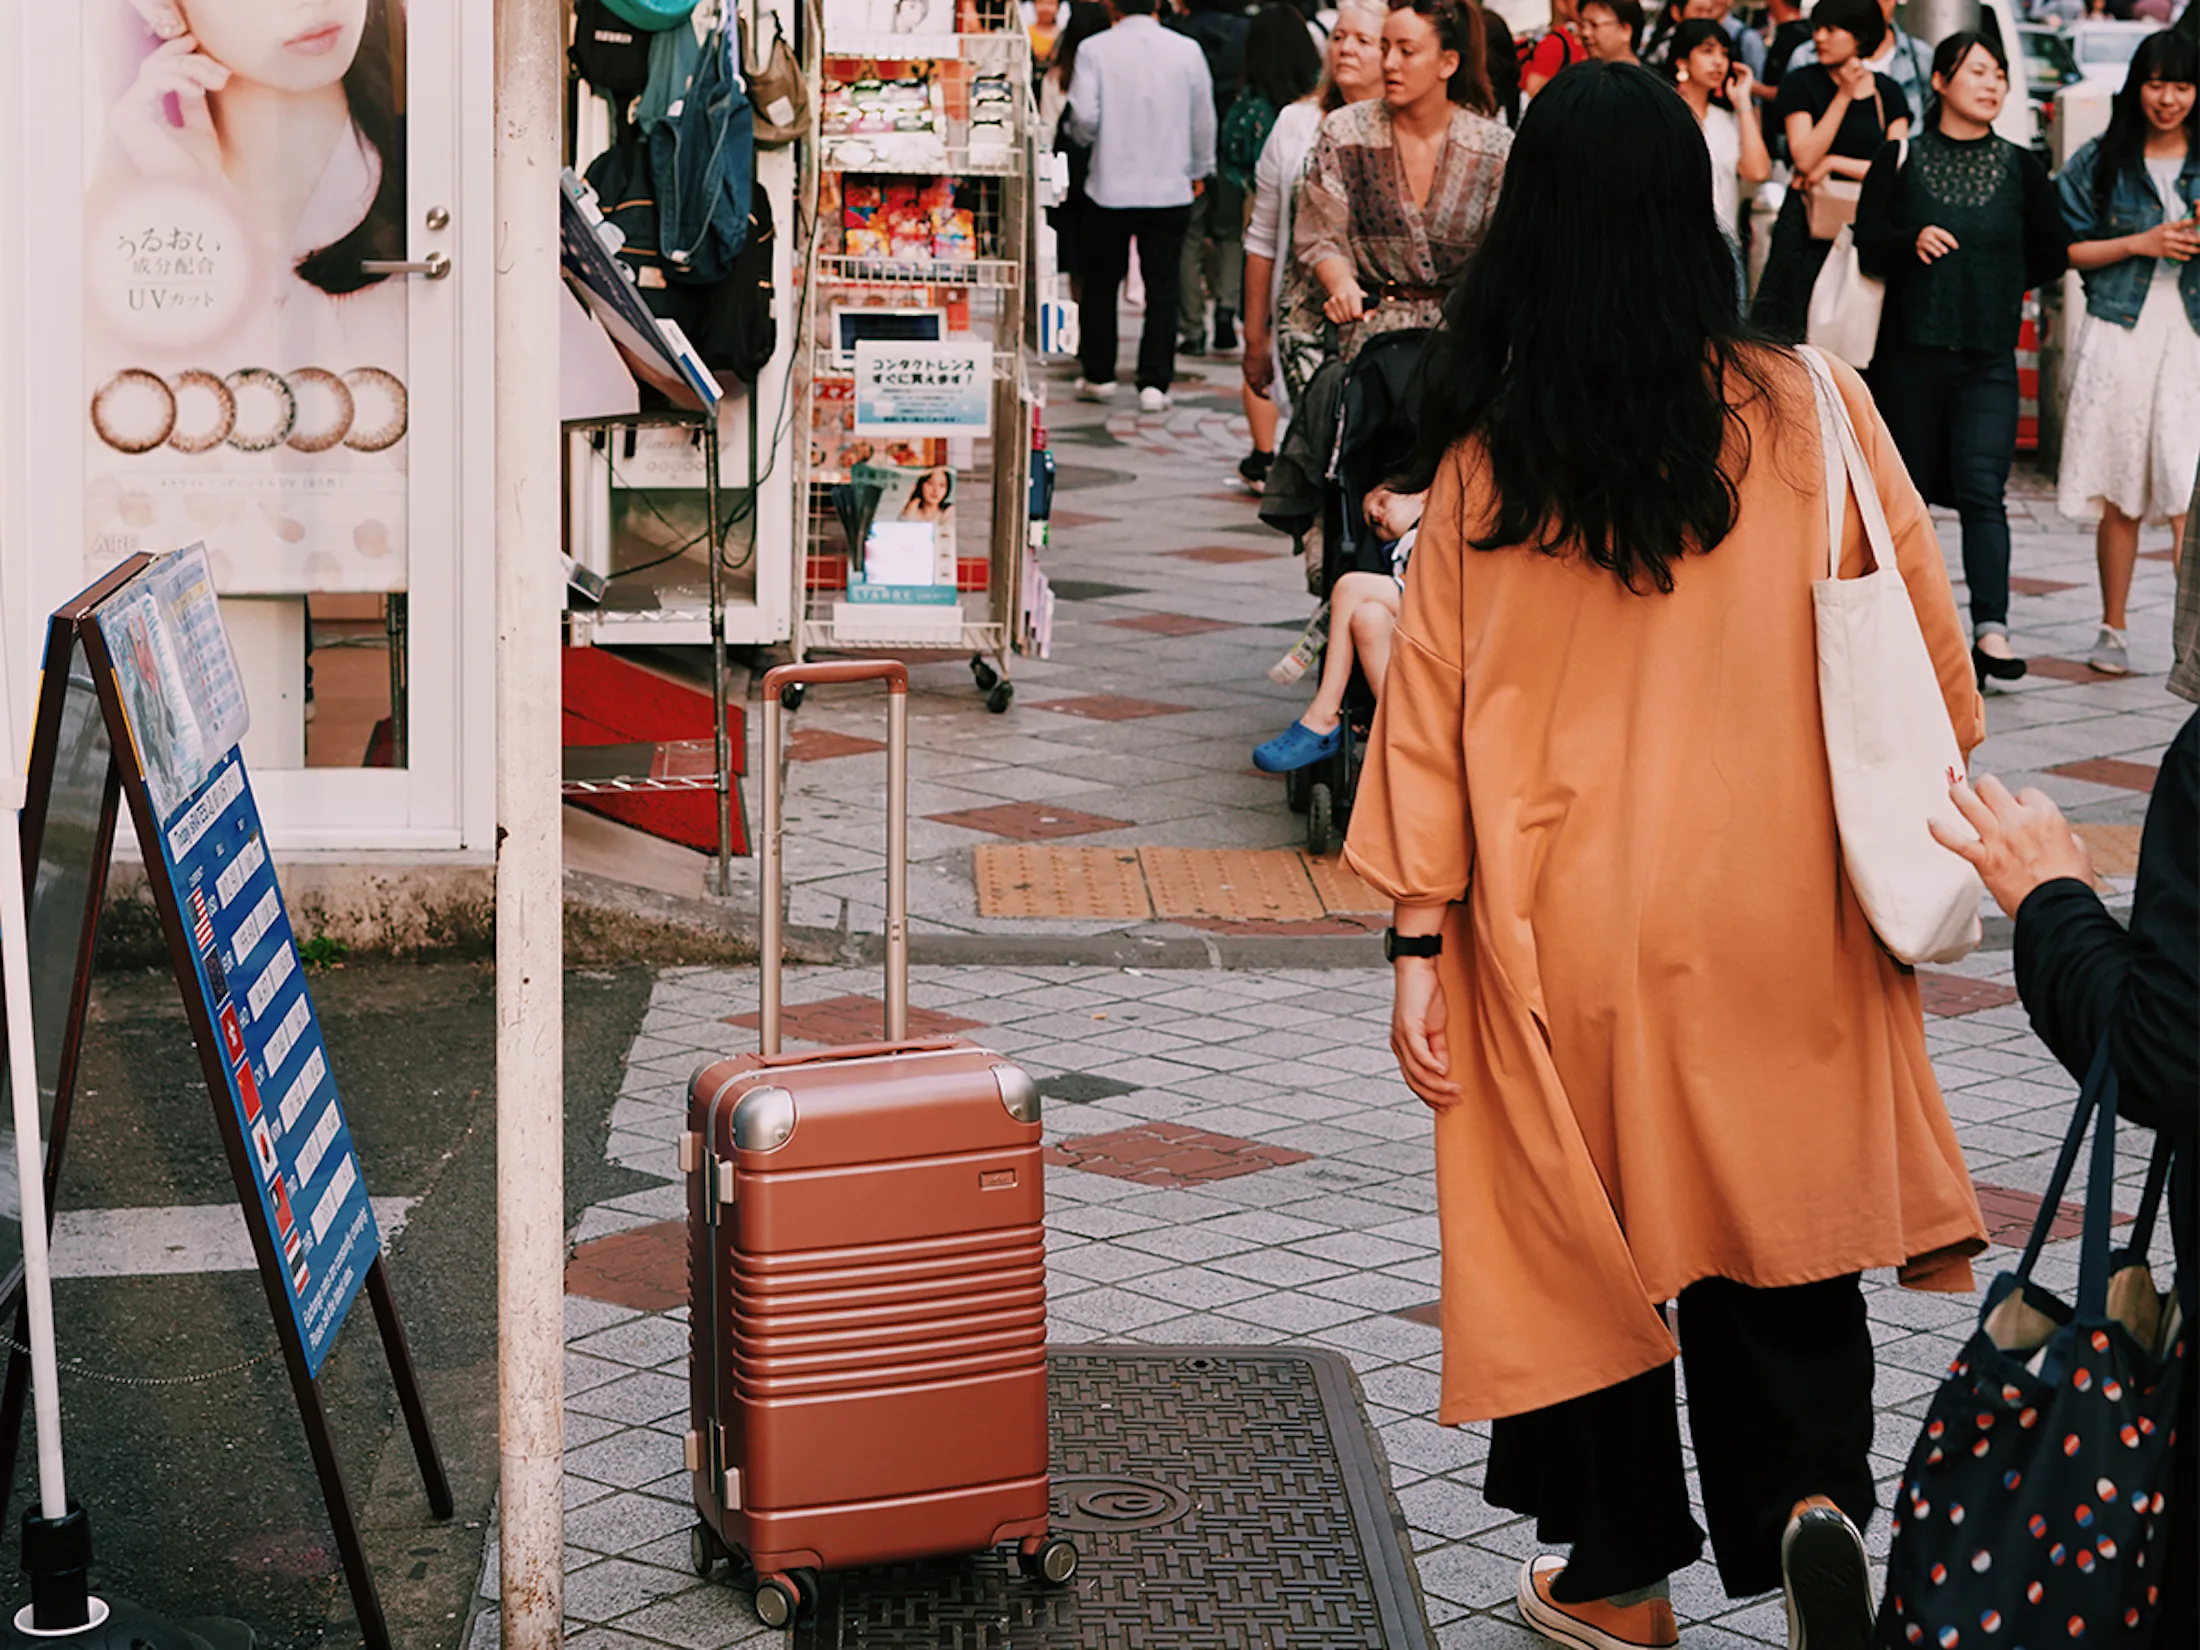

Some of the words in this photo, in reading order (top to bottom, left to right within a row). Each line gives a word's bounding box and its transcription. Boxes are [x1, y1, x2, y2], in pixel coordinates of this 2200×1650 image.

[117, 226, 221, 260] うるおい
[132, 256, 215, 276] 成分配合
